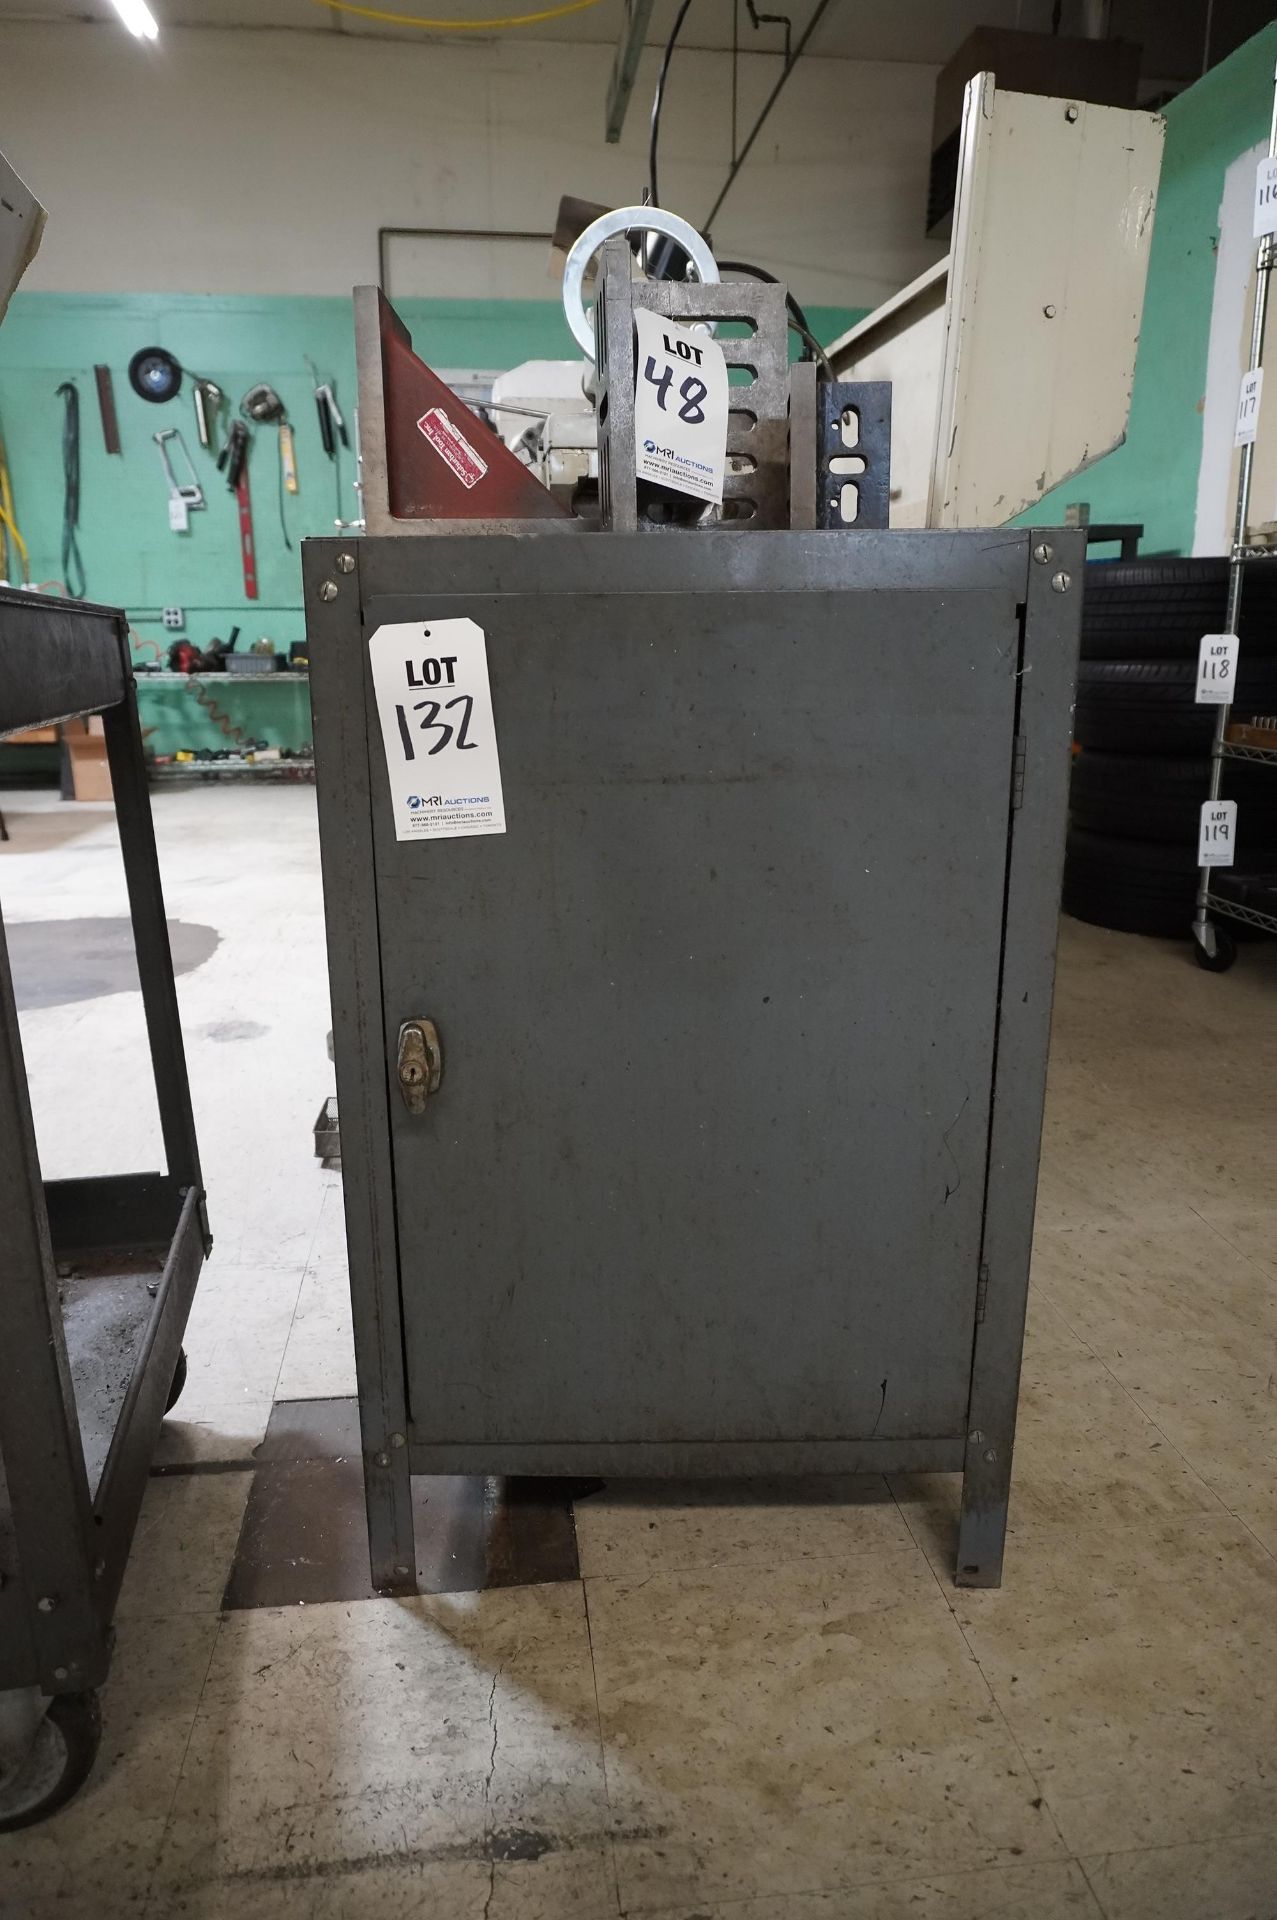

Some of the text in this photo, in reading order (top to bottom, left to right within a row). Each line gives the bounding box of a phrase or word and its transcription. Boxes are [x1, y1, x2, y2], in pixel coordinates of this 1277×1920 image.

[1267, 169, 1277, 180] LO
[663, 333, 704, 366] LOT
[644, 355, 708, 424] 48
[1246, 381, 1257, 394] LOT
[1240, 396, 1256, 420] 117
[423, 420, 434, 436] Inc.
[444, 447, 468, 477] Suburban
[656, 445, 714, 474] MRI AUCTIONS
[643, 459, 714, 487] www.mriauctions.com
[1211, 646, 1229, 656] LOT
[405, 656, 457, 687] LOT
[1203, 659, 1230, 680] 118
[395, 695, 479, 761] 132
[421, 795, 490, 807] MRI AUCTIONS
[410, 811, 493, 822] www.mriauctions.com
[1211, 811, 1228, 821] LOT
[1205, 824, 1229, 841] 119
